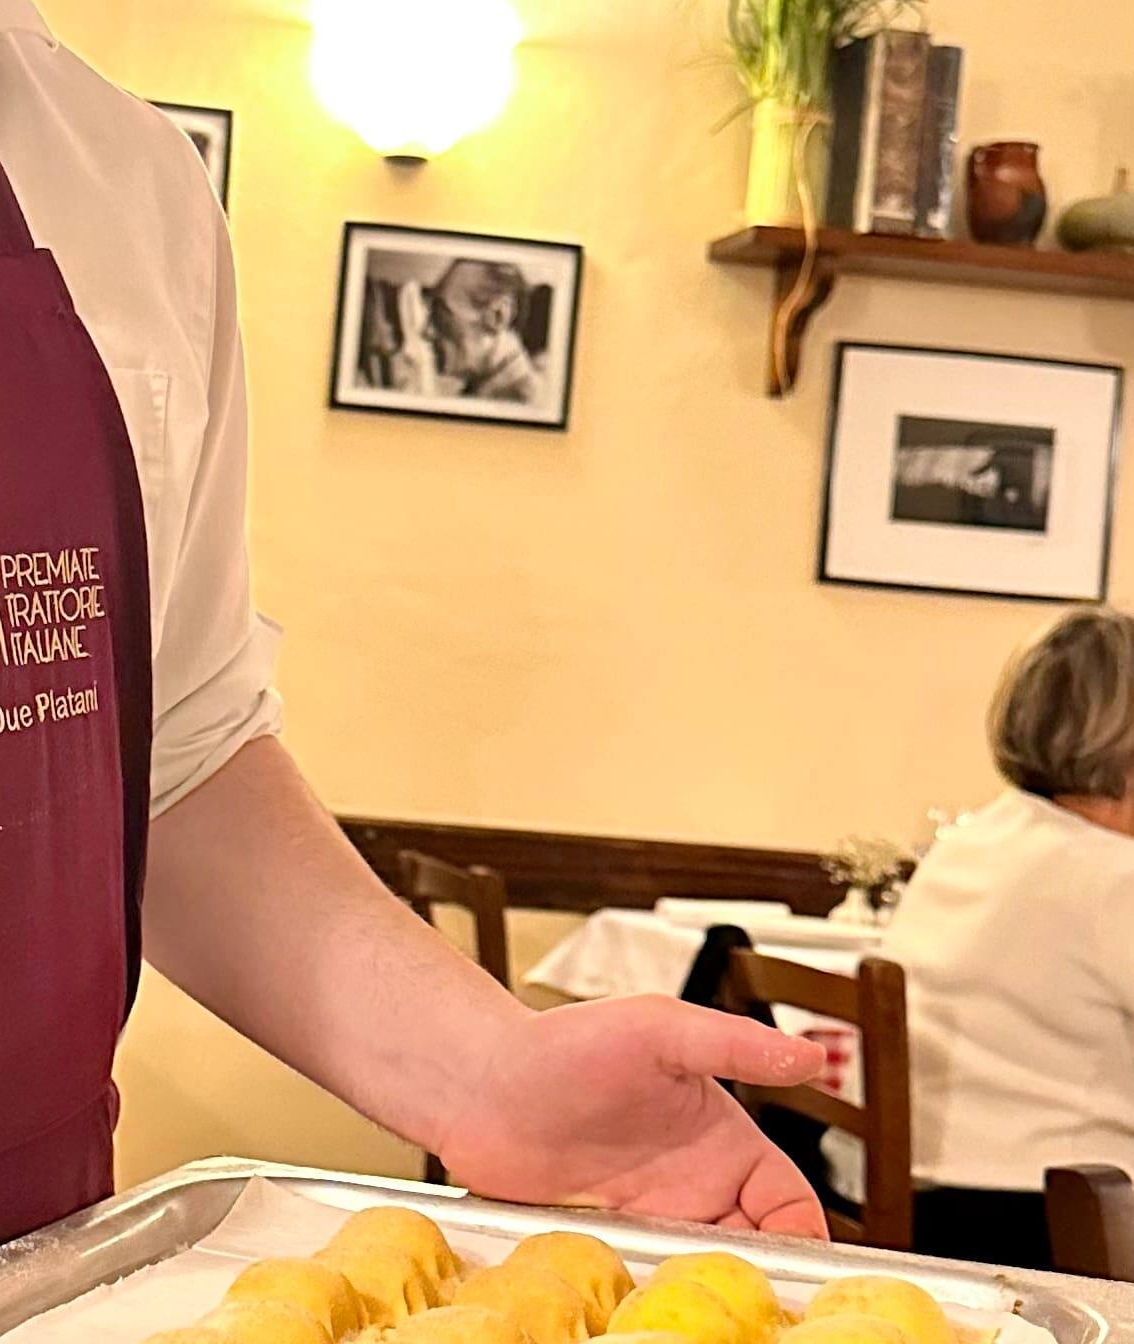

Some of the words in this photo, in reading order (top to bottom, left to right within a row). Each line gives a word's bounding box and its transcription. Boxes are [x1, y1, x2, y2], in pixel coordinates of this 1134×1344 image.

[0, 547, 100, 588] PREMIATE
[4, 585, 105, 627] TRATTORIE
[10, 625, 92, 666] ITALIANE
[35, 680, 99, 723] Platani
